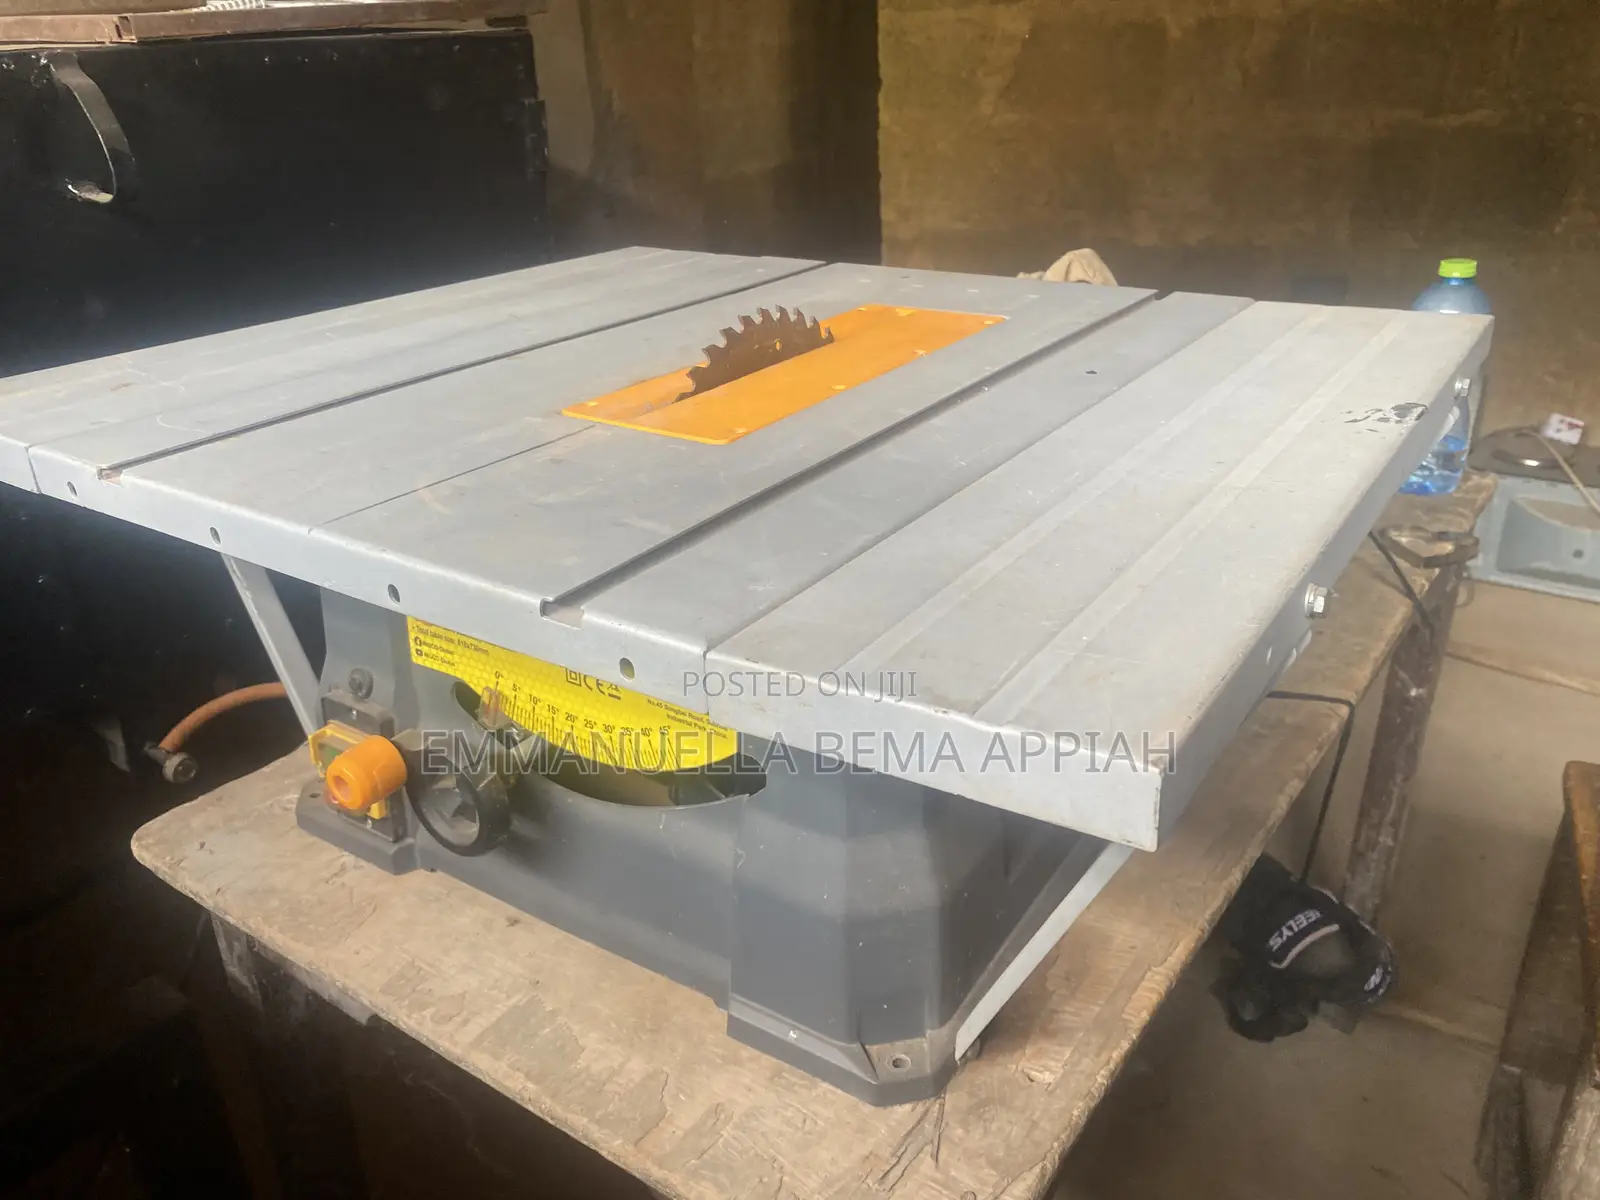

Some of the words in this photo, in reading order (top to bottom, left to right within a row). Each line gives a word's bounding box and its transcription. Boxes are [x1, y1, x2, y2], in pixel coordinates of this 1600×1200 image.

[528, 693, 541, 705] 10°
[546, 704, 560, 715] 15°
[564, 712, 578, 723] 20°
[584, 718, 597, 730] 25°
[602, 723, 616, 734] 30°
[640, 727, 653, 738] 40°
